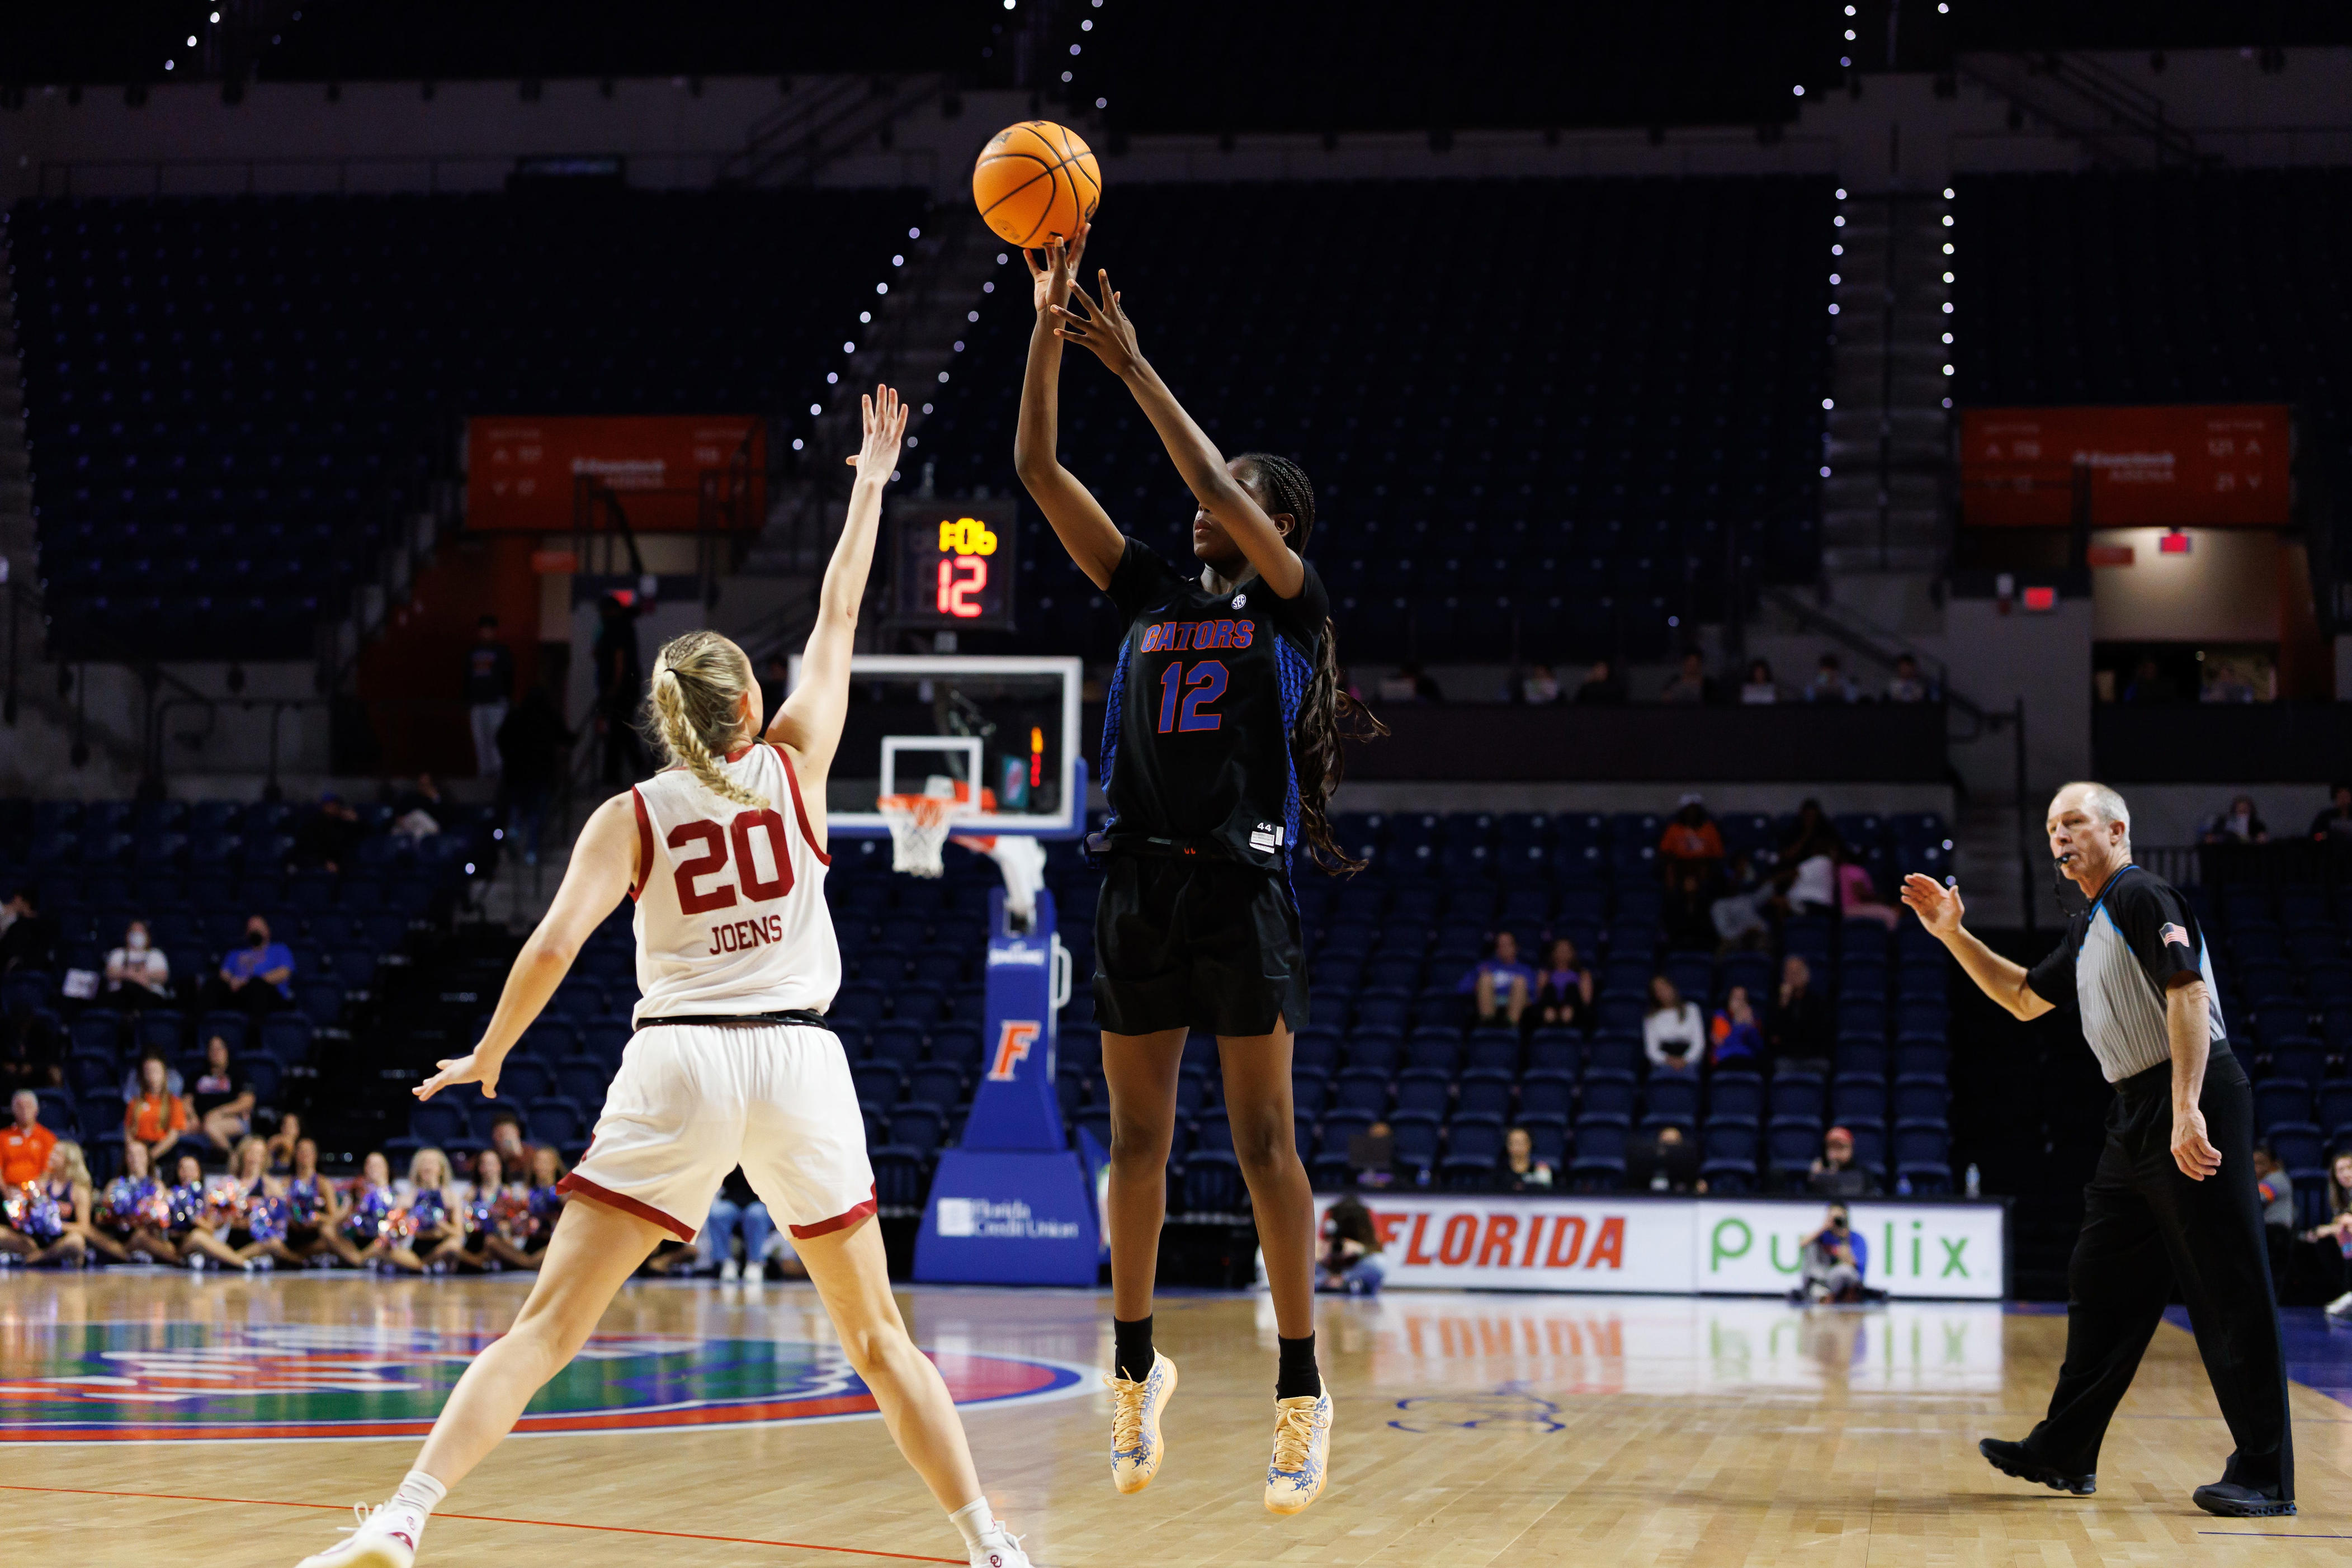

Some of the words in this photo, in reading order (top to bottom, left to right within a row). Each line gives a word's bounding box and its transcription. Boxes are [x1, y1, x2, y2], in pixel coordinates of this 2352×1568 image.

[938, 555, 988, 617] 12
[1232, 595, 1245, 608] SEC
[1141, 619, 1255, 653] GATORS
[1158, 660, 1229, 733] 12
[1257, 823, 1272, 832] 44
[667, 808, 795, 915] 20
[709, 915, 782, 955] JOENS
[988, 1019, 1041, 1081] F
[1377, 1213, 1626, 1269] FLORIDA
[1711, 1217, 1970, 1278] Pulix
